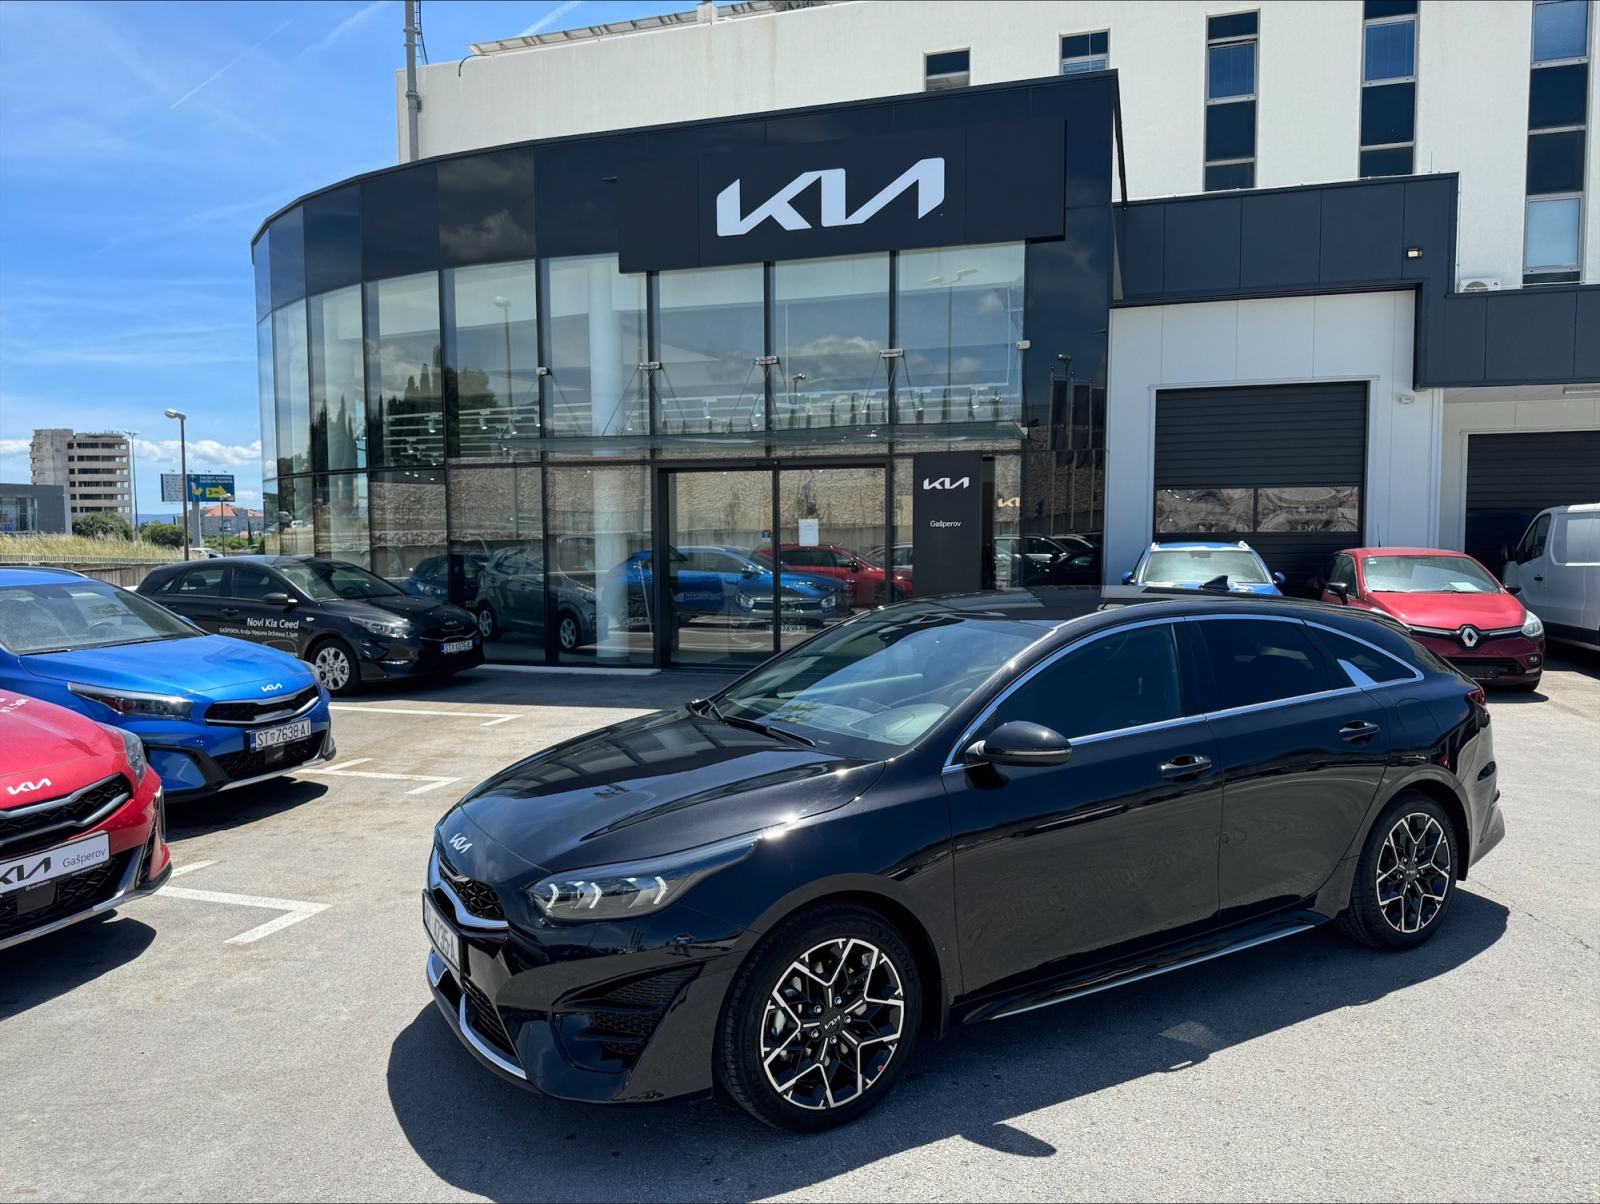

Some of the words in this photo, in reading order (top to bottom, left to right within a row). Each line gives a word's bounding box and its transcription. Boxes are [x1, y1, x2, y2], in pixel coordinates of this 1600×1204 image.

[717, 157, 945, 236] KIA
[923, 477, 970, 490] KIA
[997, 497, 1021, 507] KI
[929, 520, 962, 529] Gašperov
[247, 617, 264, 628] Novi
[265, 618, 278, 628] Kia
[279, 619, 299, 630] Ceed
[261, 684, 282, 692] KIA
[257, 731, 270, 748] ST
[7, 778, 52, 795] KIA
[450, 832, 473, 855] KIA
[62, 848, 106, 868] Gašperov
